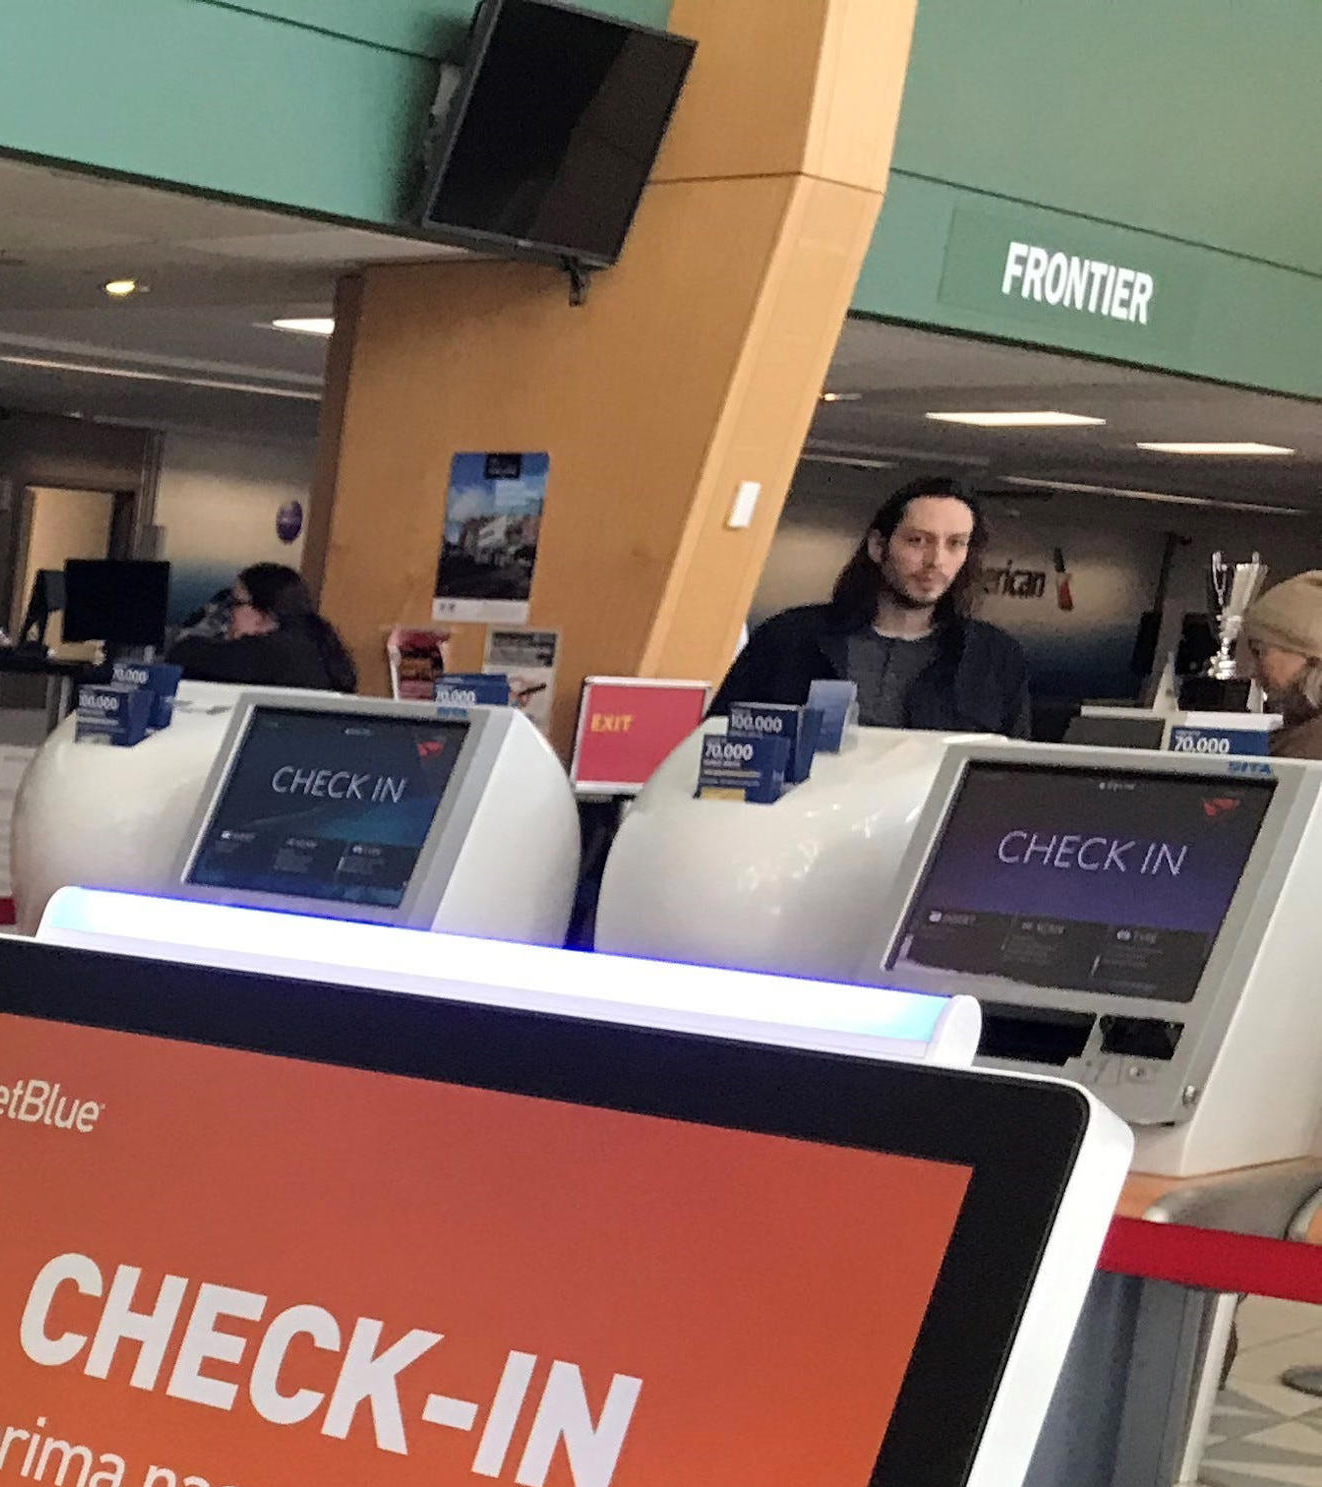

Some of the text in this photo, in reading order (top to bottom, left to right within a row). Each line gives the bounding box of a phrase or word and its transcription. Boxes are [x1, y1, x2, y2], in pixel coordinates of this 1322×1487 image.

[1002, 241, 1154, 325] FRONTIER
[590, 713, 633, 732] EXIT
[272, 765, 407, 803] CHECK IN
[997, 830, 1188, 877] CHECK IN
